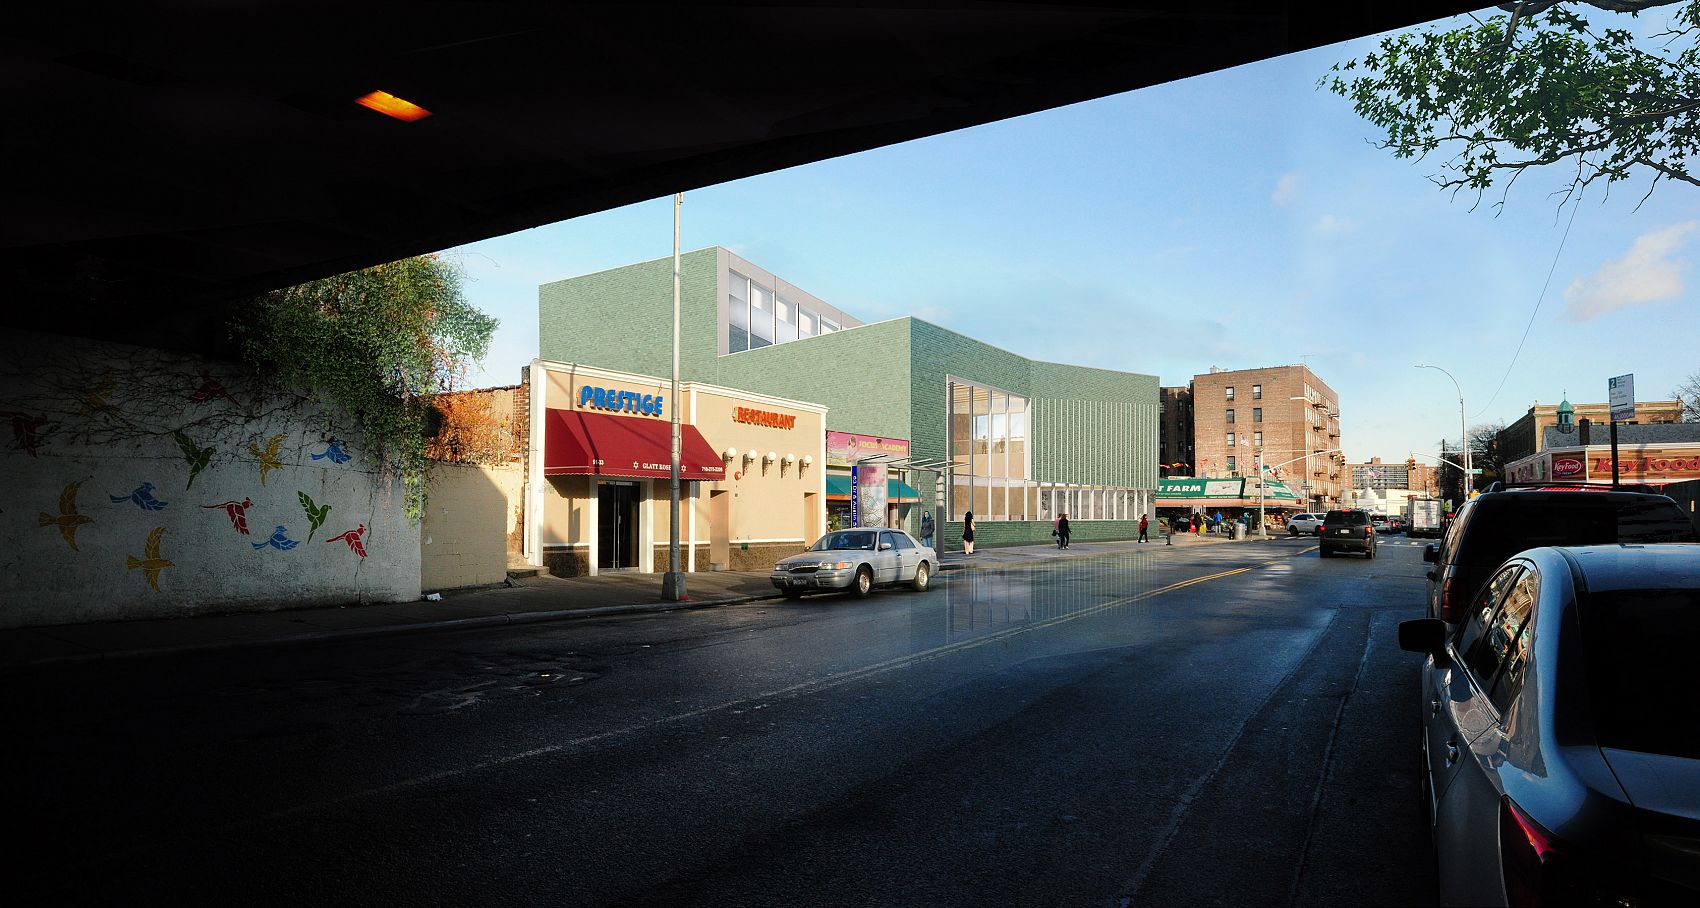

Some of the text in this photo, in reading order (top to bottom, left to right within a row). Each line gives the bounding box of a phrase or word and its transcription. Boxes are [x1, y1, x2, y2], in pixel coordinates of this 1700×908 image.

[580, 385, 664, 415] PRESTIGE
[736, 406, 797, 428] RESTAURANT
[642, 462, 659, 470] GLATT
[1554, 462, 1579, 471] Key Food
[1597, 456, 1700, 474] Key Food
